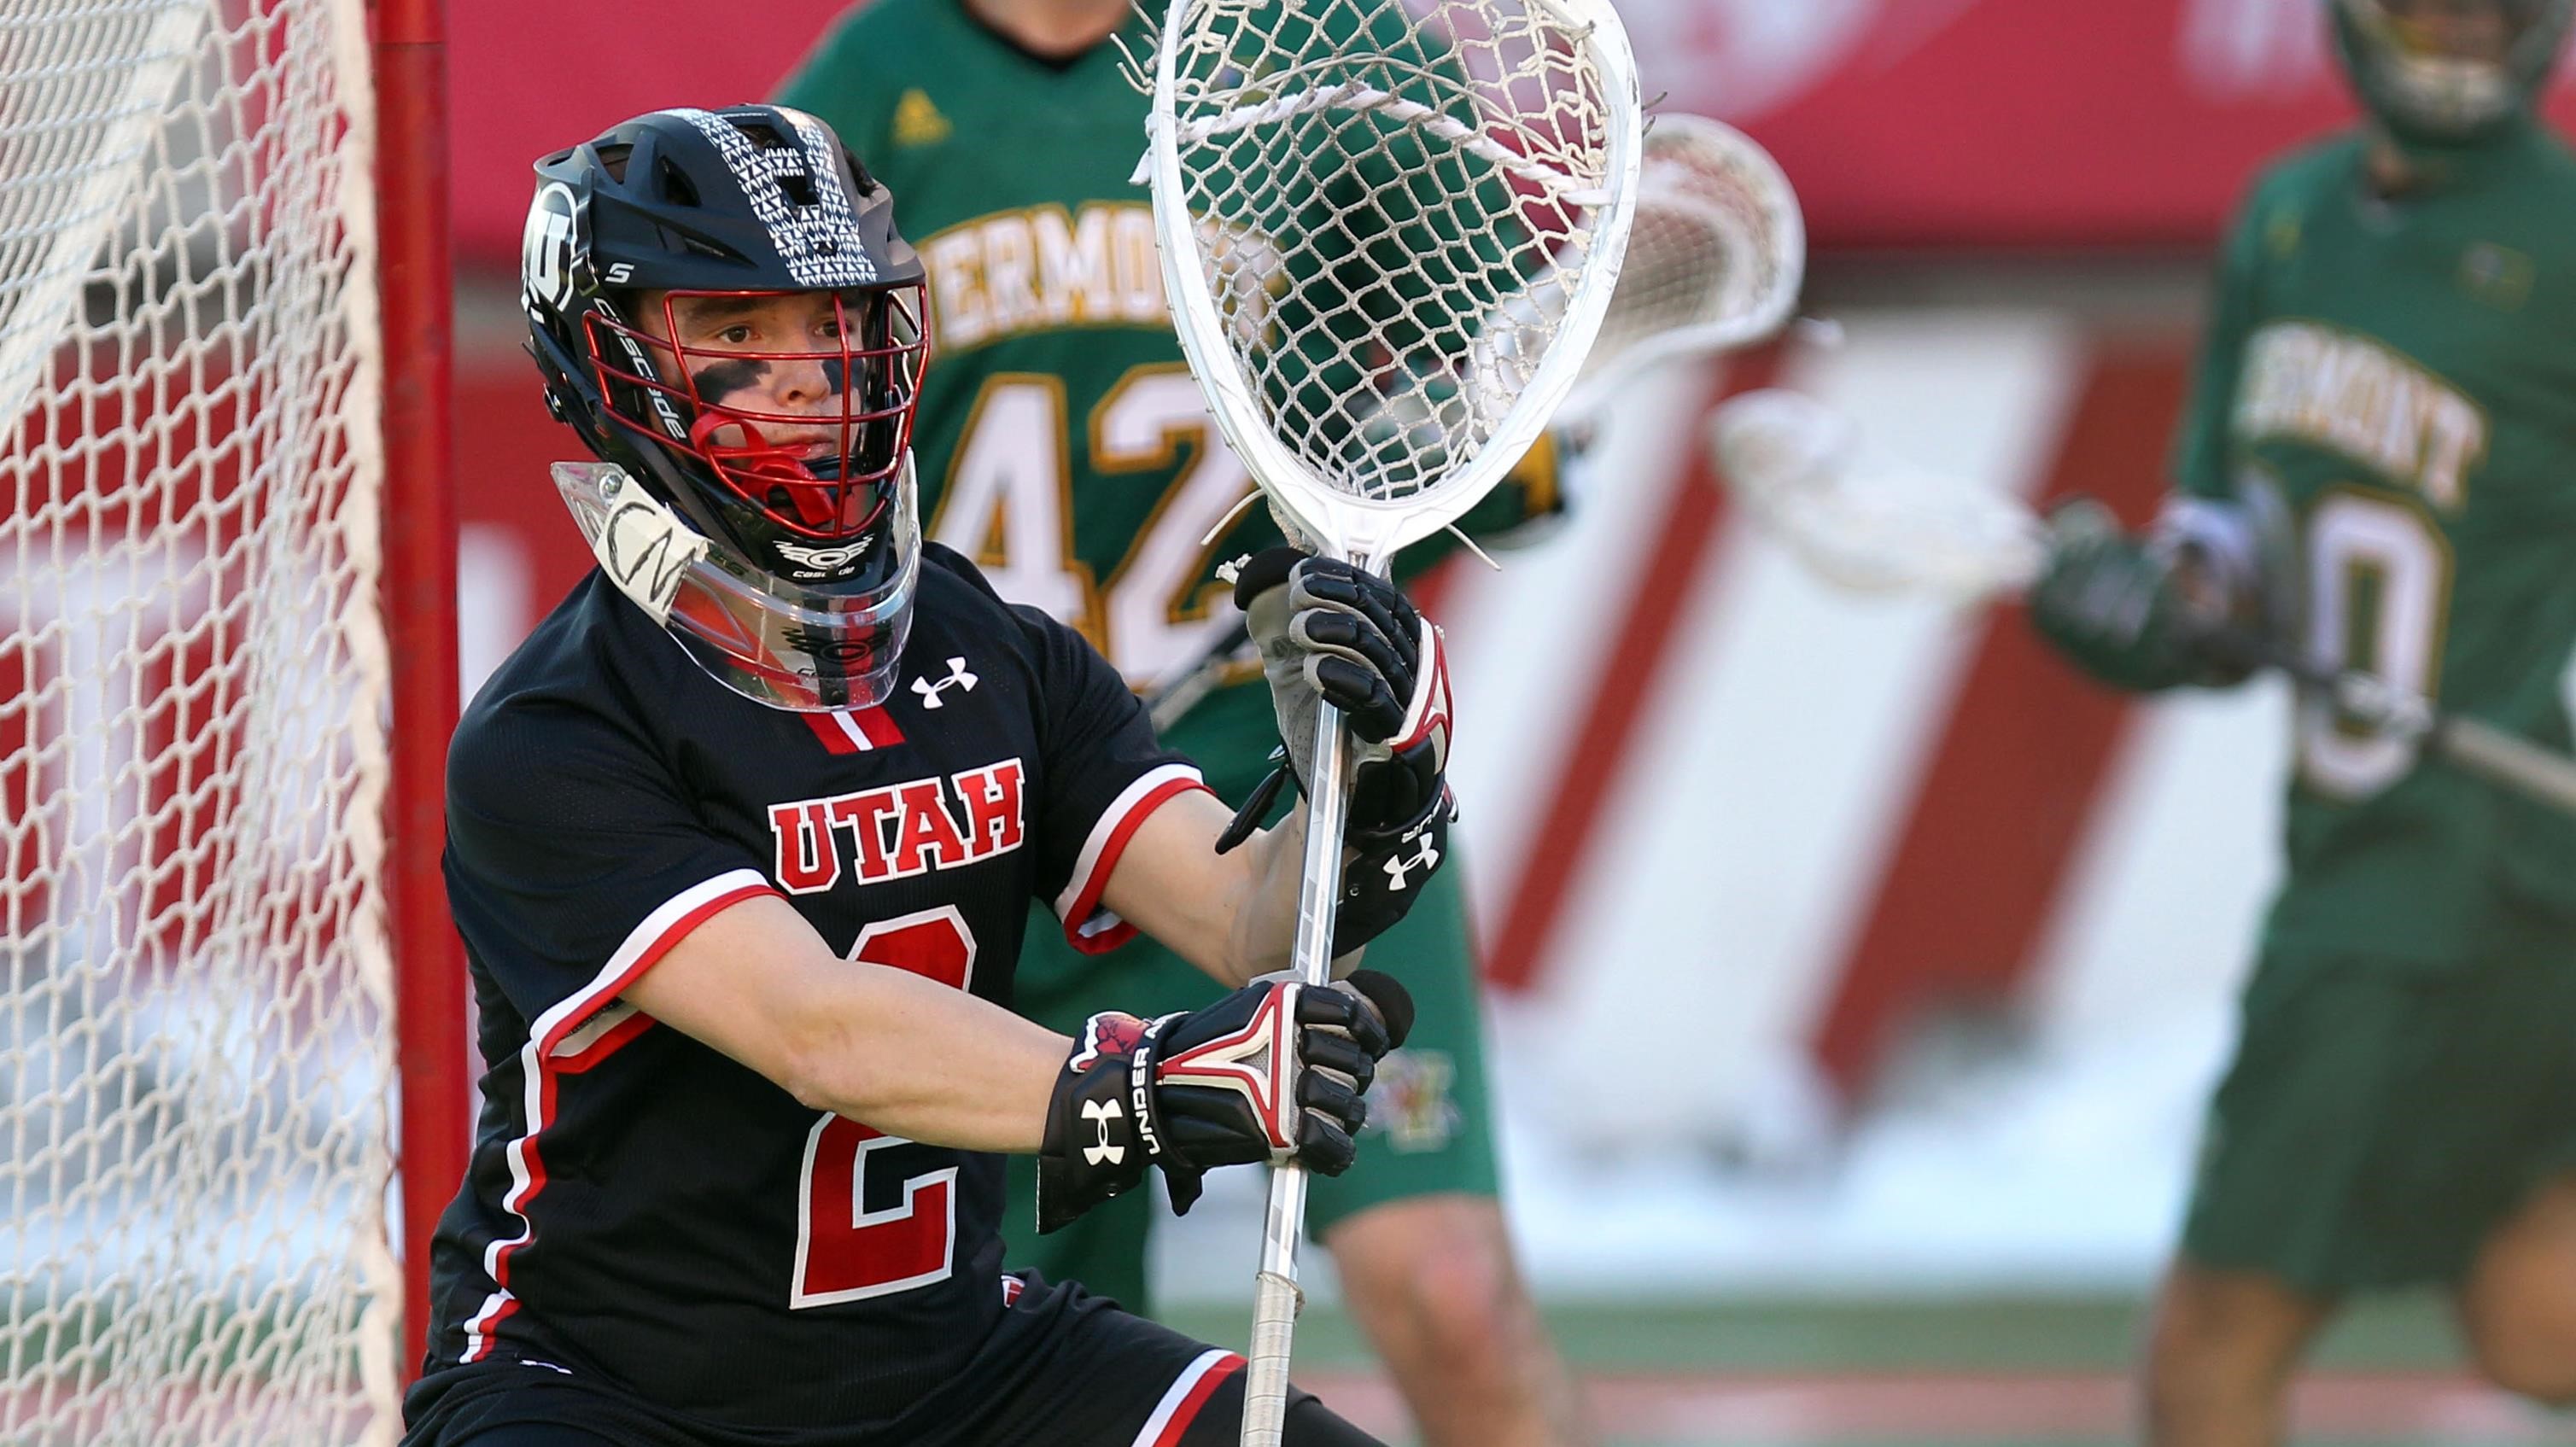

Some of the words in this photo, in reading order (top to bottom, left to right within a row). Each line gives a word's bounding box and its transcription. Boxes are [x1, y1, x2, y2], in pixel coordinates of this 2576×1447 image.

[926, 361, 1265, 693] 42
[768, 757, 1025, 896] UTAH
[790, 904, 977, 1310] 2
[1131, 1047, 1161, 1155] UNDER
